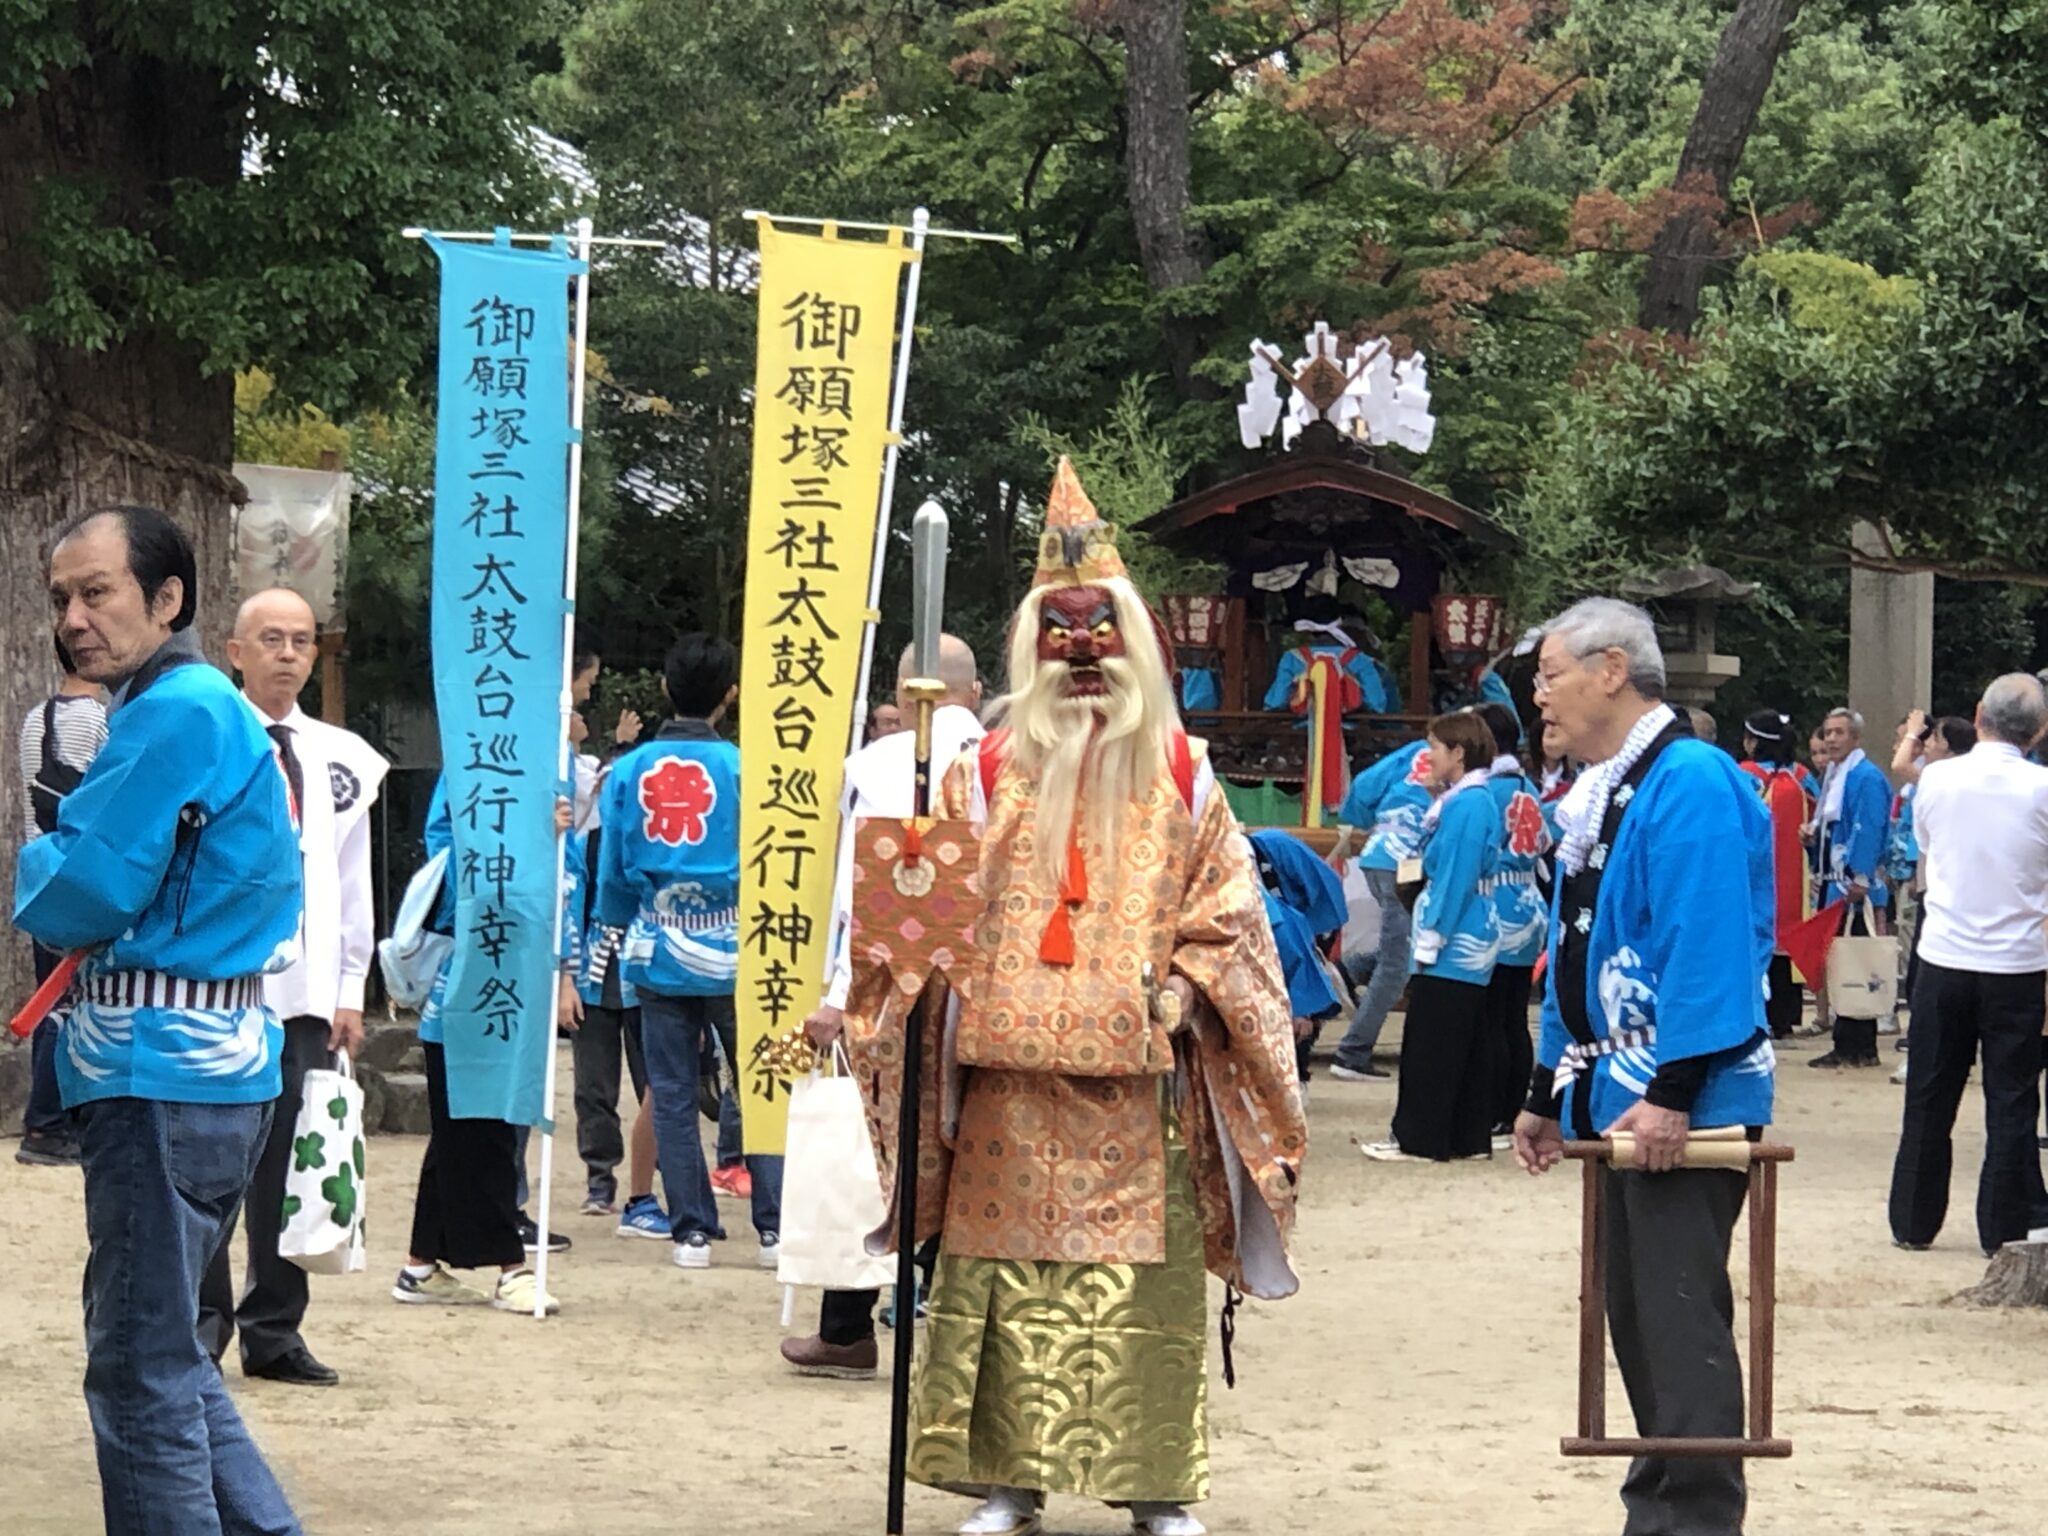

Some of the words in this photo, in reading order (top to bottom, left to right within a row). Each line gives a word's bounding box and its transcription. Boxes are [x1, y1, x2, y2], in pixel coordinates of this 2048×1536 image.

[461, 295, 535, 1044] 御願塚三社太鼓台巡行神幸祭
[640, 757, 715, 846] 祭
[745, 290, 862, 1103] 御願塚三社太鼓台巡行神幸祭
